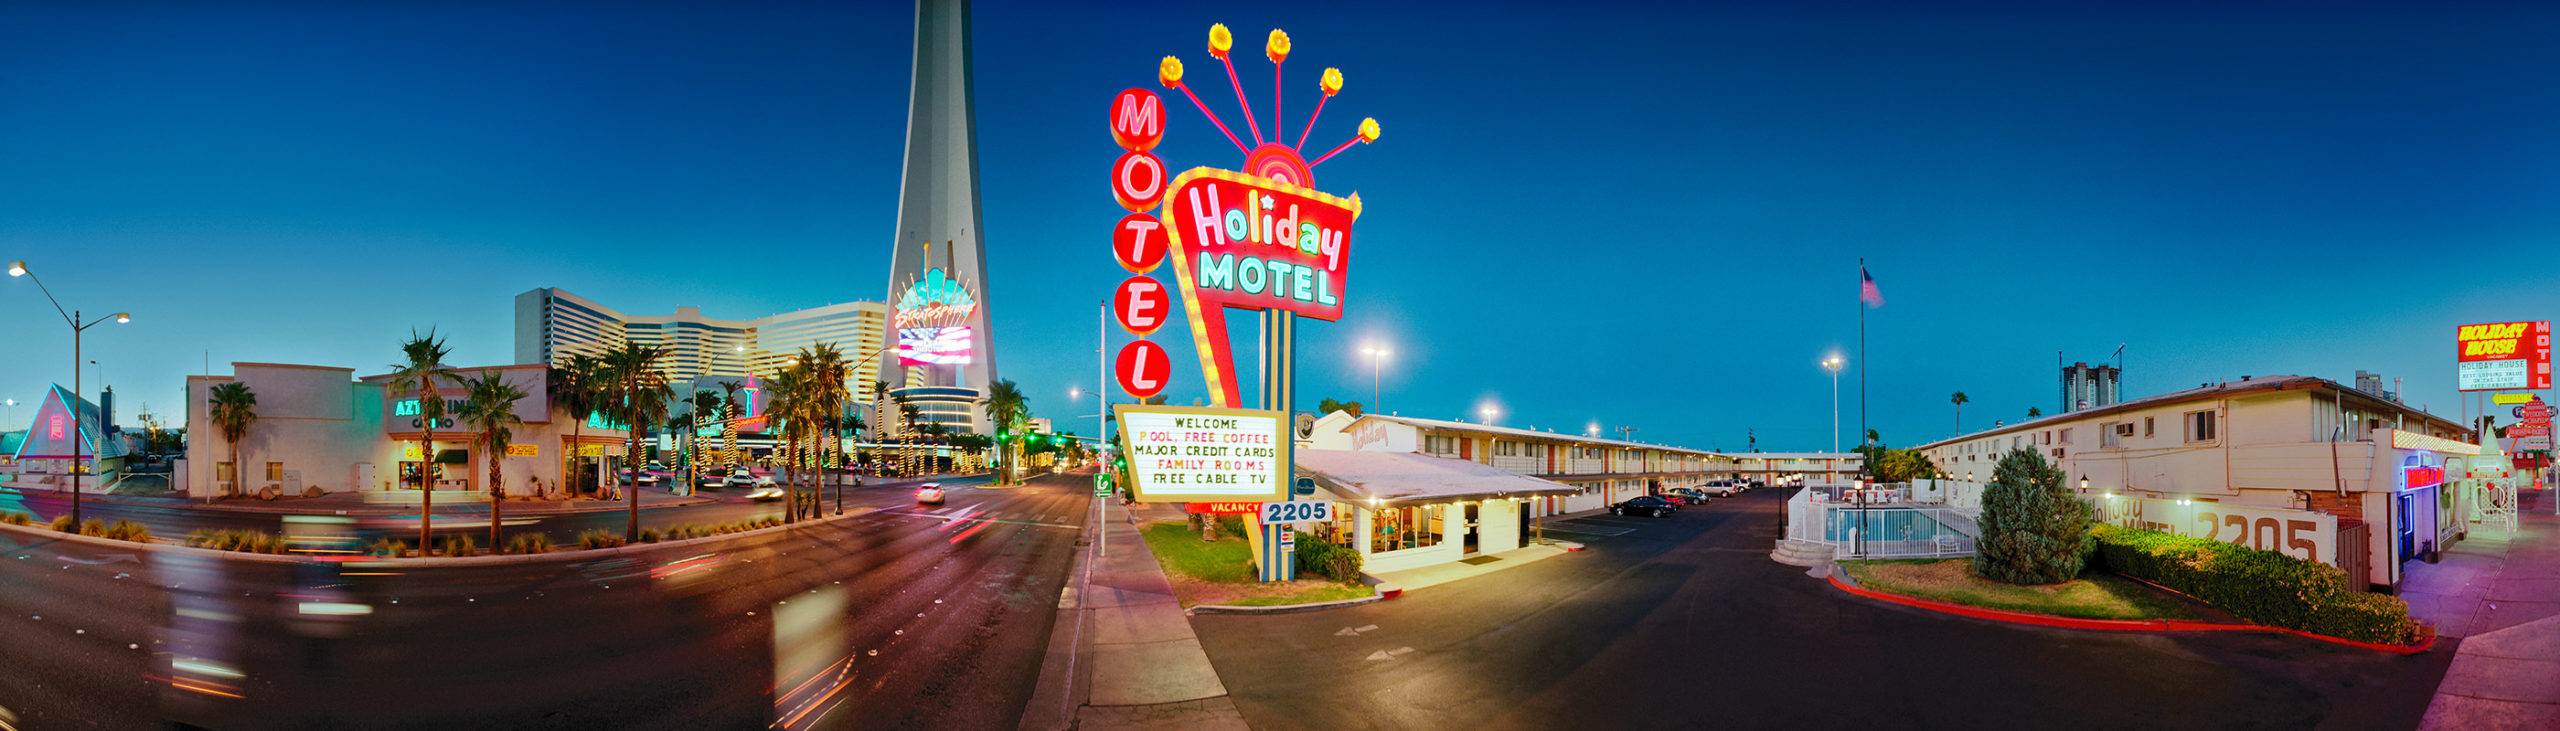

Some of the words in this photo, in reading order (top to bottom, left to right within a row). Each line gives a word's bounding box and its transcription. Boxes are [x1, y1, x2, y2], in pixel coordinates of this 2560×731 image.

[1189, 183, 1343, 271] Holiday
[1118, 94, 1161, 389] MOTEL
[1199, 251, 1338, 306] MOTEL
[2459, 323, 2528, 341] HOLIDAY
[2465, 339, 2517, 356] HOUSE
[2536, 321, 2550, 388] MOTEL
[2461, 362, 2493, 370] HOLIDAY
[2499, 360, 2524, 368] HOUSE
[1175, 418, 1237, 429] WELCOME
[1140, 431, 1177, 443] POOL,
[1185, 432, 1215, 442] FREE
[1223, 433, 1269, 444] COFFEE
[1352, 420, 1389, 455] Holiday
[1134, 445, 1178, 456] MAJOR
[1186, 446, 1228, 456] CREDIT
[1235, 447, 1274, 457] CARDS
[1158, 459, 1204, 470] FAMILY
[1215, 460, 1264, 471] ROOMS
[1153, 473, 1185, 484] FREE
[1196, 474, 1237, 484] CABLE
[1250, 474, 1266, 484] TV
[1211, 503, 1260, 513] VACANCY
[1268, 503, 1326, 522] 2205
[2198, 512, 2317, 562] 2205
